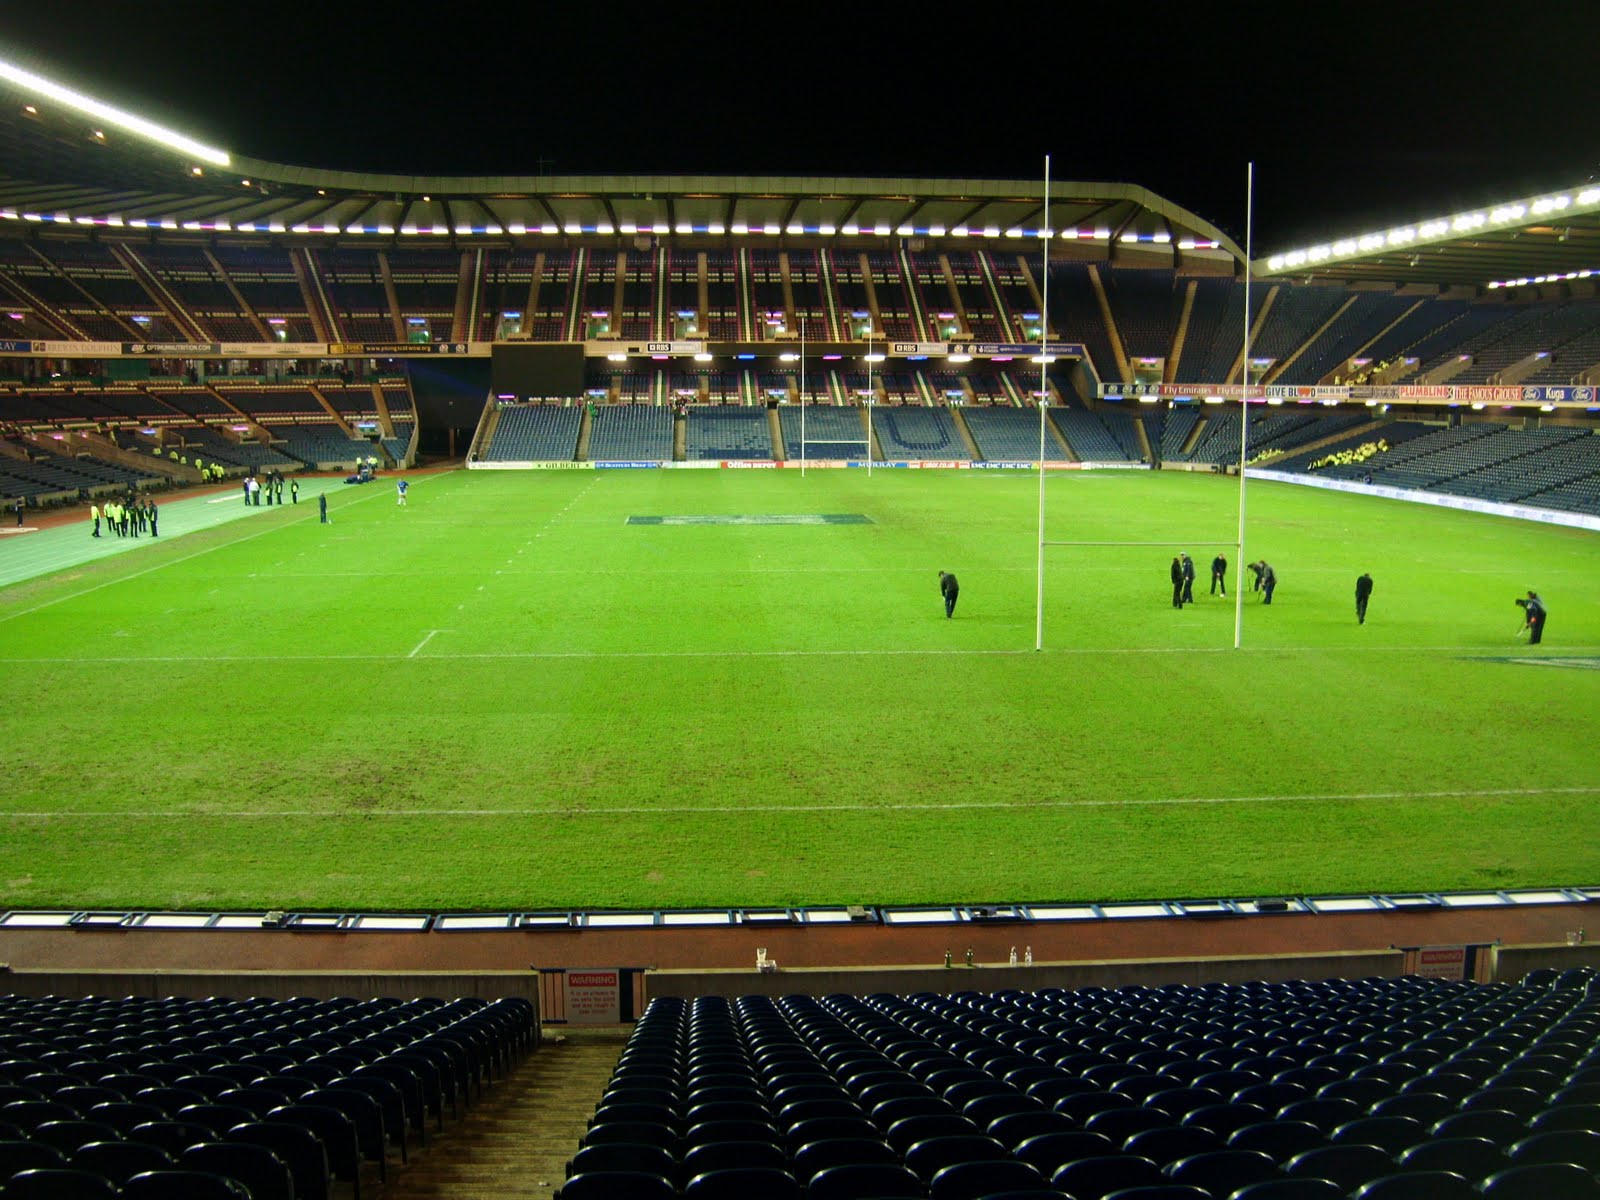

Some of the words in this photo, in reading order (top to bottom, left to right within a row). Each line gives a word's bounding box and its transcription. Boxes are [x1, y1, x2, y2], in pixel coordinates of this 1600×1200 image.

[656, 343, 669, 351] RBS
[903, 344, 916, 352] RBS
[1164, 386, 1177, 395] Fly
[1179, 386, 1212, 394] Emirates
[1217, 386, 1229, 395] Fly
[1231, 387, 1262, 395] Emrates
[1265, 387, 1286, 397] GIVE
[1288, 387, 1316, 397] BLD
[1455, 386, 1468, 399] THE
[1469, 386, 1493, 400] FAMOUS
[1494, 387, 1519, 400] GROUSE
[1546, 387, 1564, 402] Kuga
[727, 461, 751, 469] Office
[571, 976, 615, 984] WARNING
